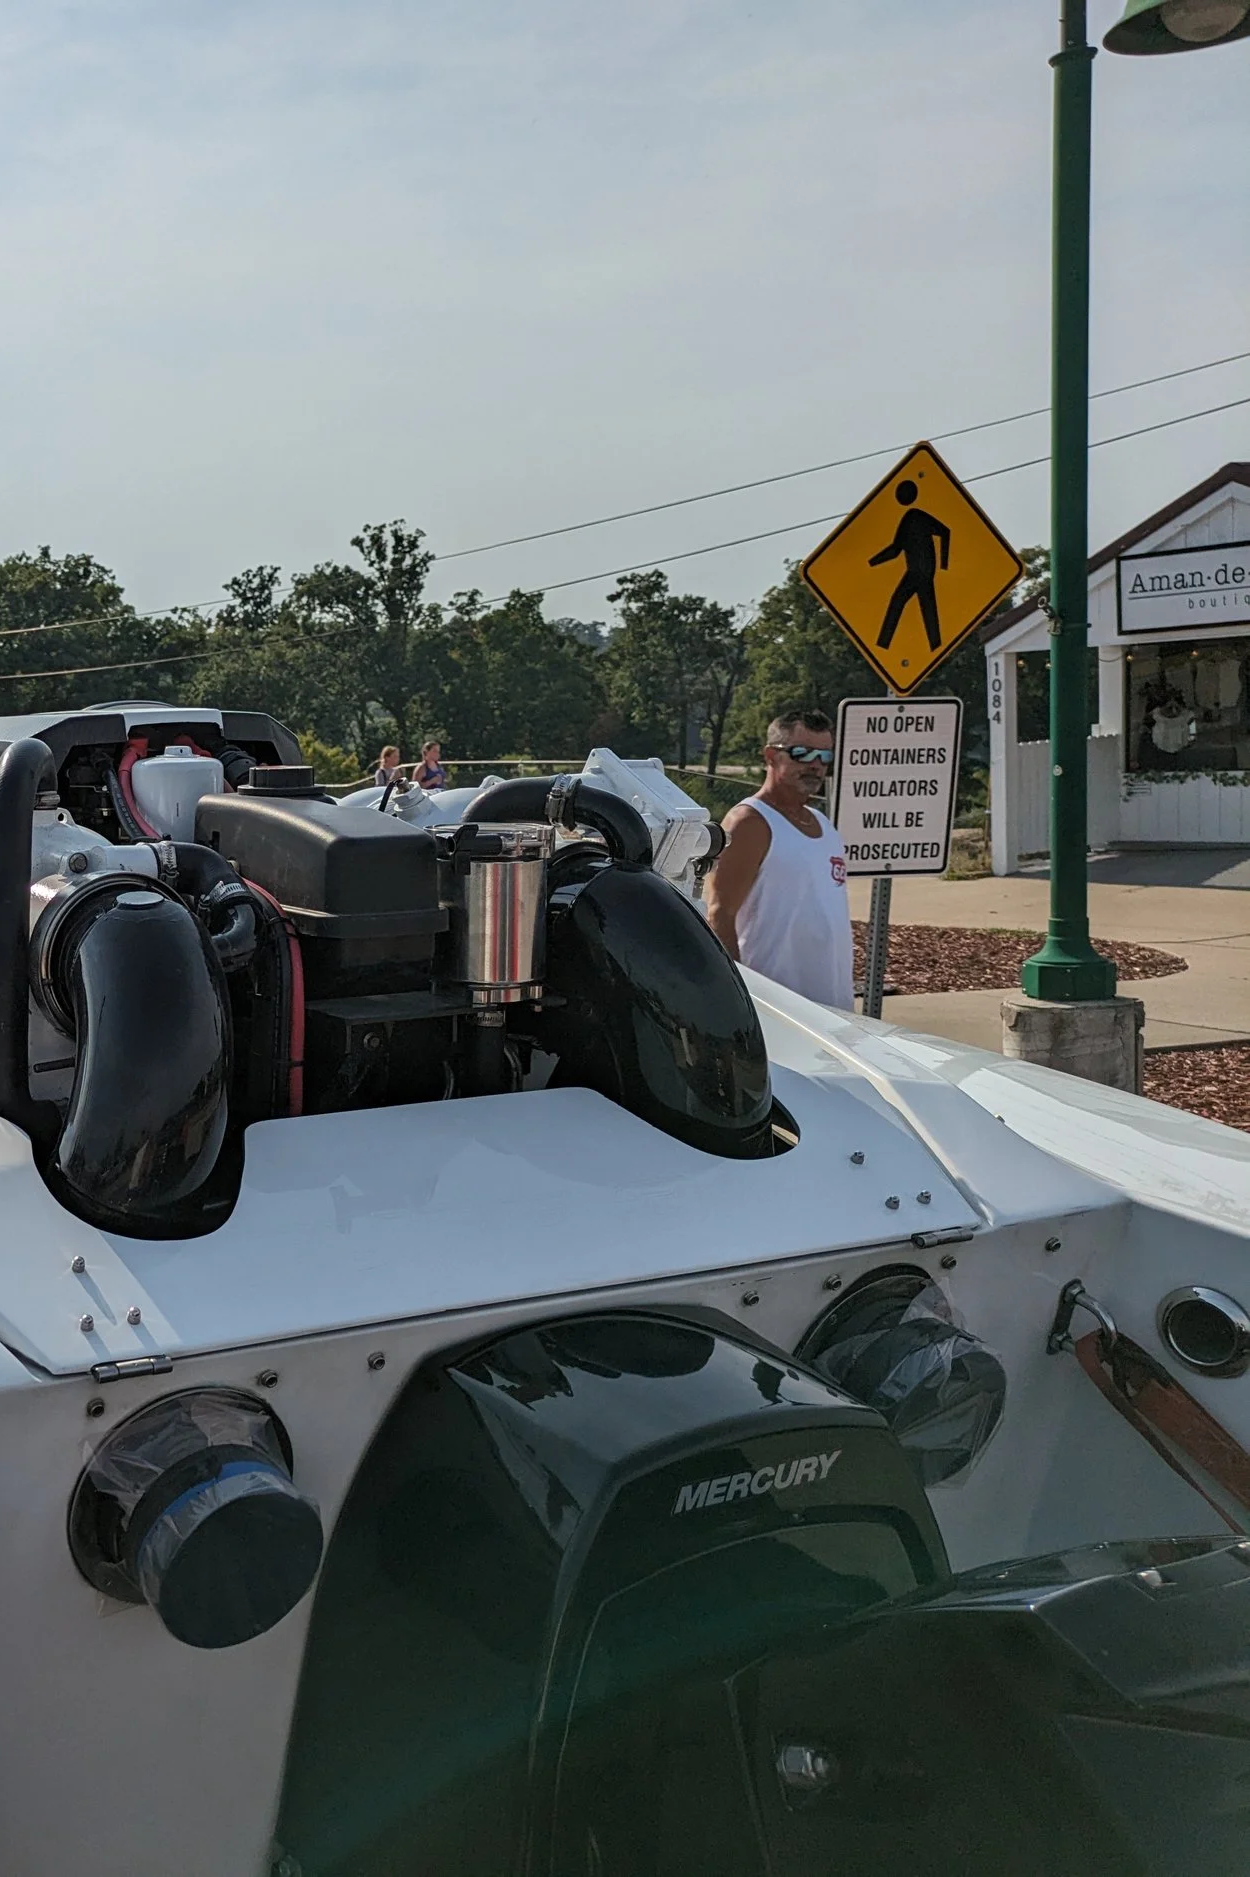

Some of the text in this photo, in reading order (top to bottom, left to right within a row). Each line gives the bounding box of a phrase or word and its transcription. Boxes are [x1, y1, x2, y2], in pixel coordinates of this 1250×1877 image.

[992, 662, 1001, 724] 1084
[866, 716, 935, 733] NO OPEN
[850, 748, 946, 766] CONTAINERS
[853, 779, 938, 797] VIOLATORS
[862, 811, 924, 829] WILL BE
[672, 1449, 842, 1516] MERCURY
